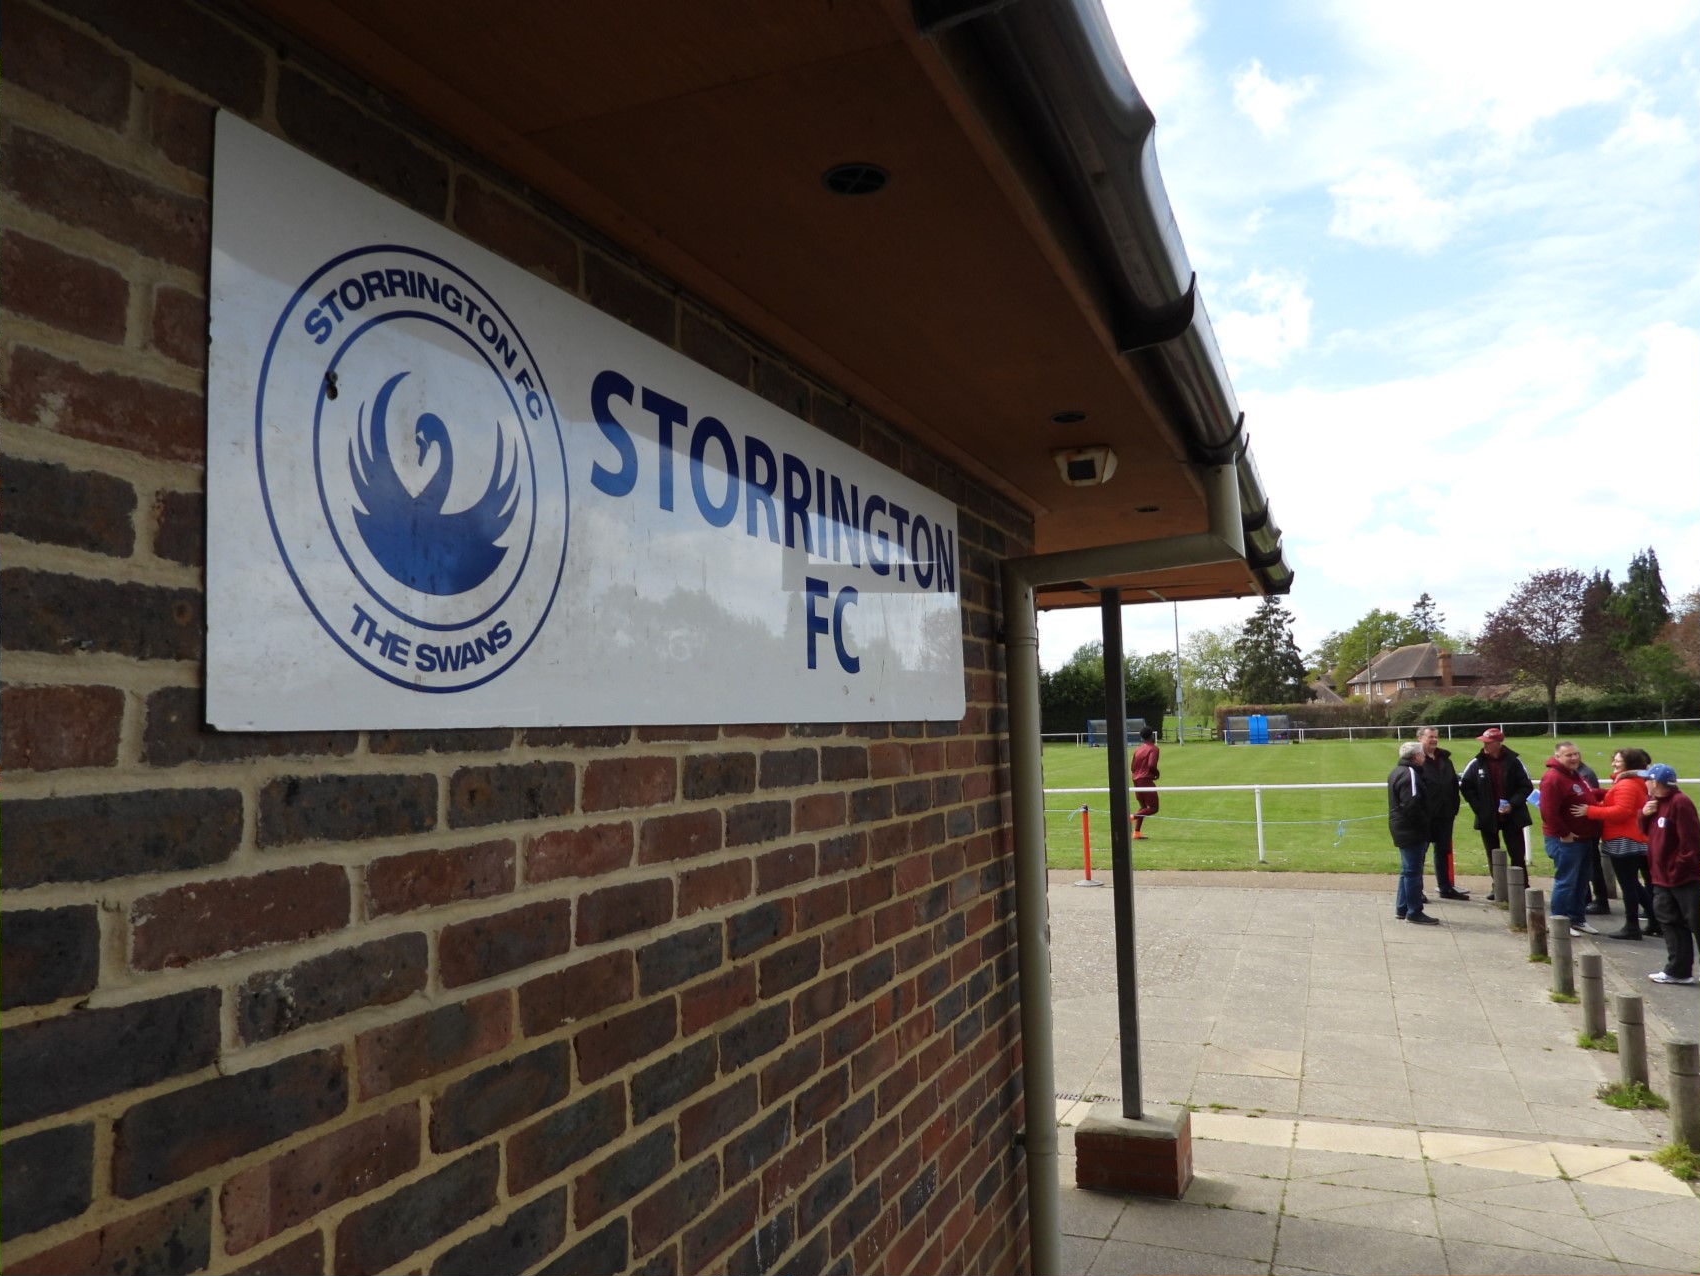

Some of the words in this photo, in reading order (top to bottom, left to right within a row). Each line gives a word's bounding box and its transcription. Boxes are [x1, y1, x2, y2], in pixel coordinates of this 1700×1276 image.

[304, 268, 518, 373] STORRINGTON
[516, 366, 545, 422] FC
[590, 370, 956, 593] STORRINGTON
[350, 603, 409, 668] THE
[415, 619, 513, 672] SWANS
[805, 576, 862, 674] FC
